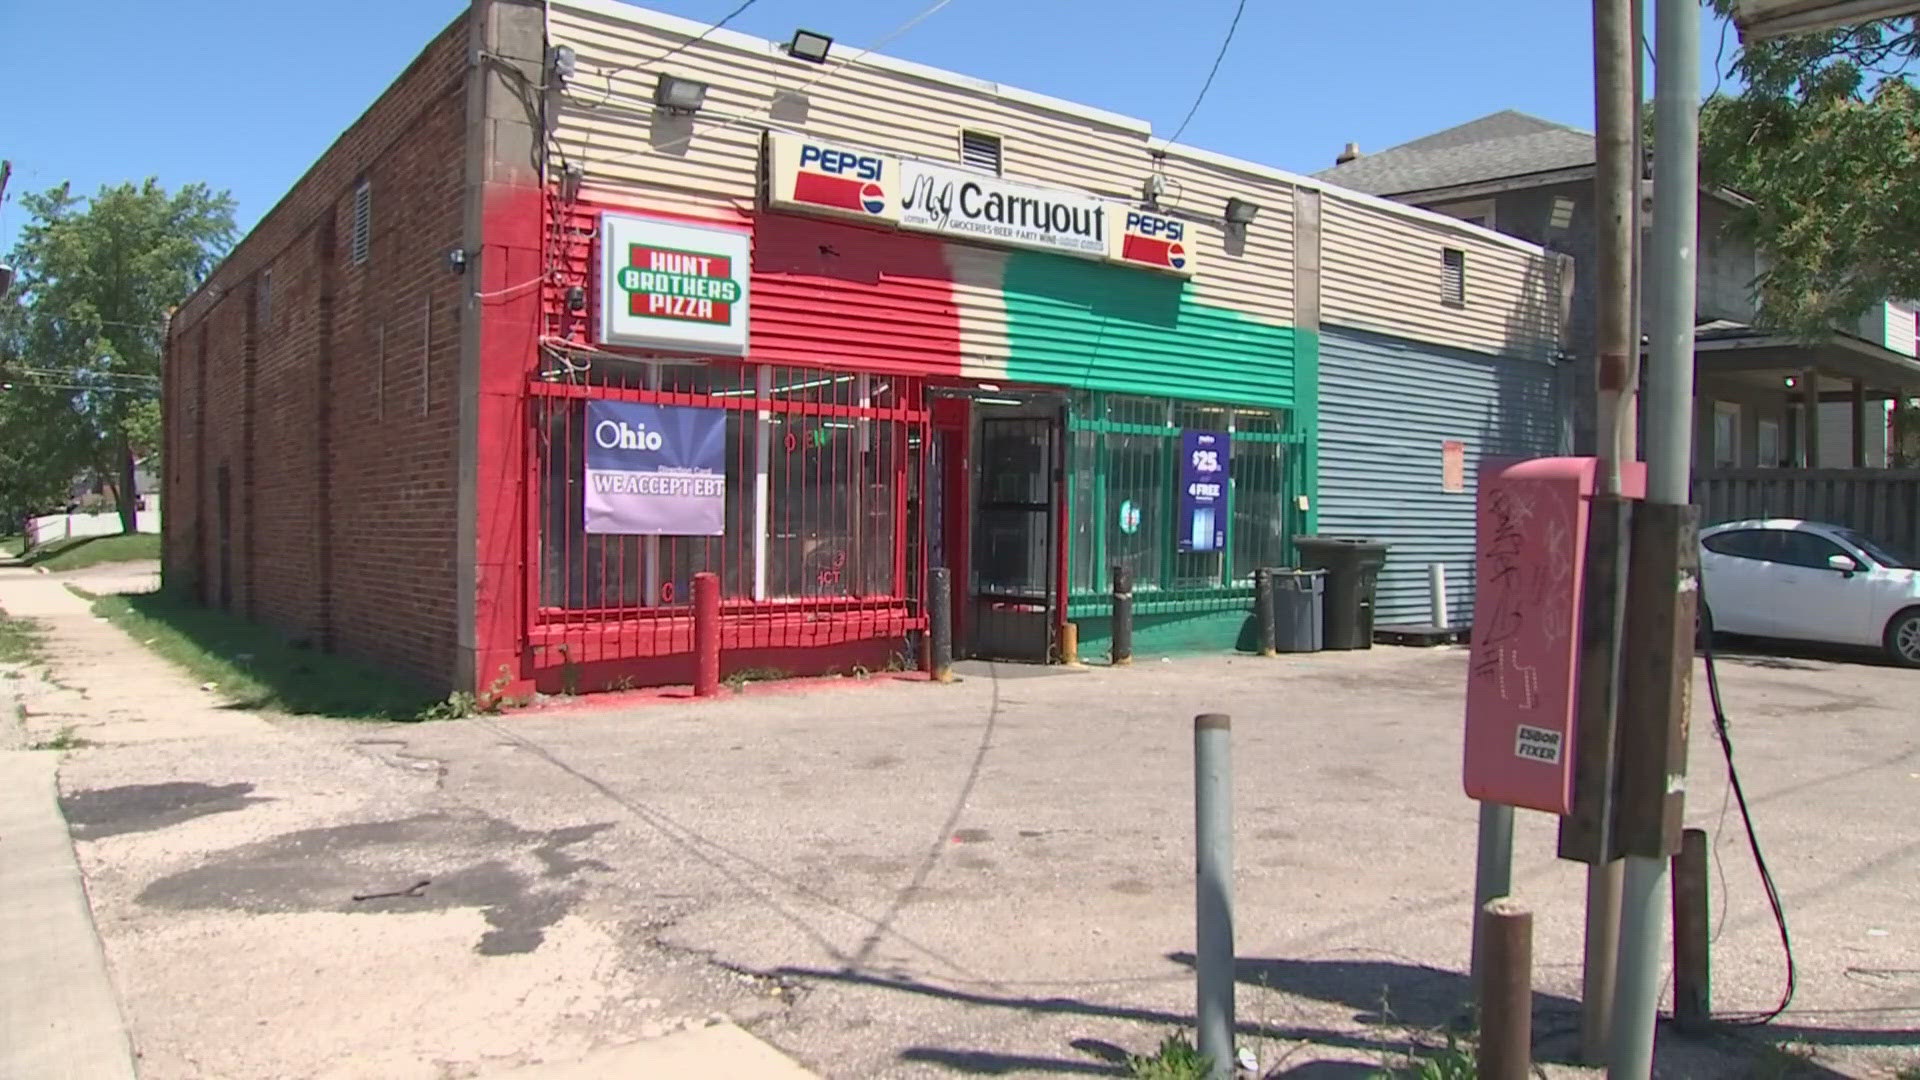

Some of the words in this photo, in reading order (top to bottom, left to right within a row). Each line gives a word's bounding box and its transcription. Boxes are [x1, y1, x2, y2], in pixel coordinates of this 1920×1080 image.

[800, 144, 883, 181] PEPSI
[960, 182, 1105, 242] Carryout
[1016, 229, 1037, 241] PARTY
[1126, 212, 1184, 241] PEPSI
[651, 251, 711, 277] HUNT
[625, 270, 735, 300] BROTHERS
[649, 294, 712, 319] PIZZA
[595, 420, 662, 450] Ohio
[593, 475, 622, 494] WE
[626, 475, 691, 495] ACCEPT
[694, 478, 725, 496] EBT
[1188, 483, 1196, 496] 4
[1197, 483, 1221, 497] FREE
[1519, 743, 1557, 760] FIXER
